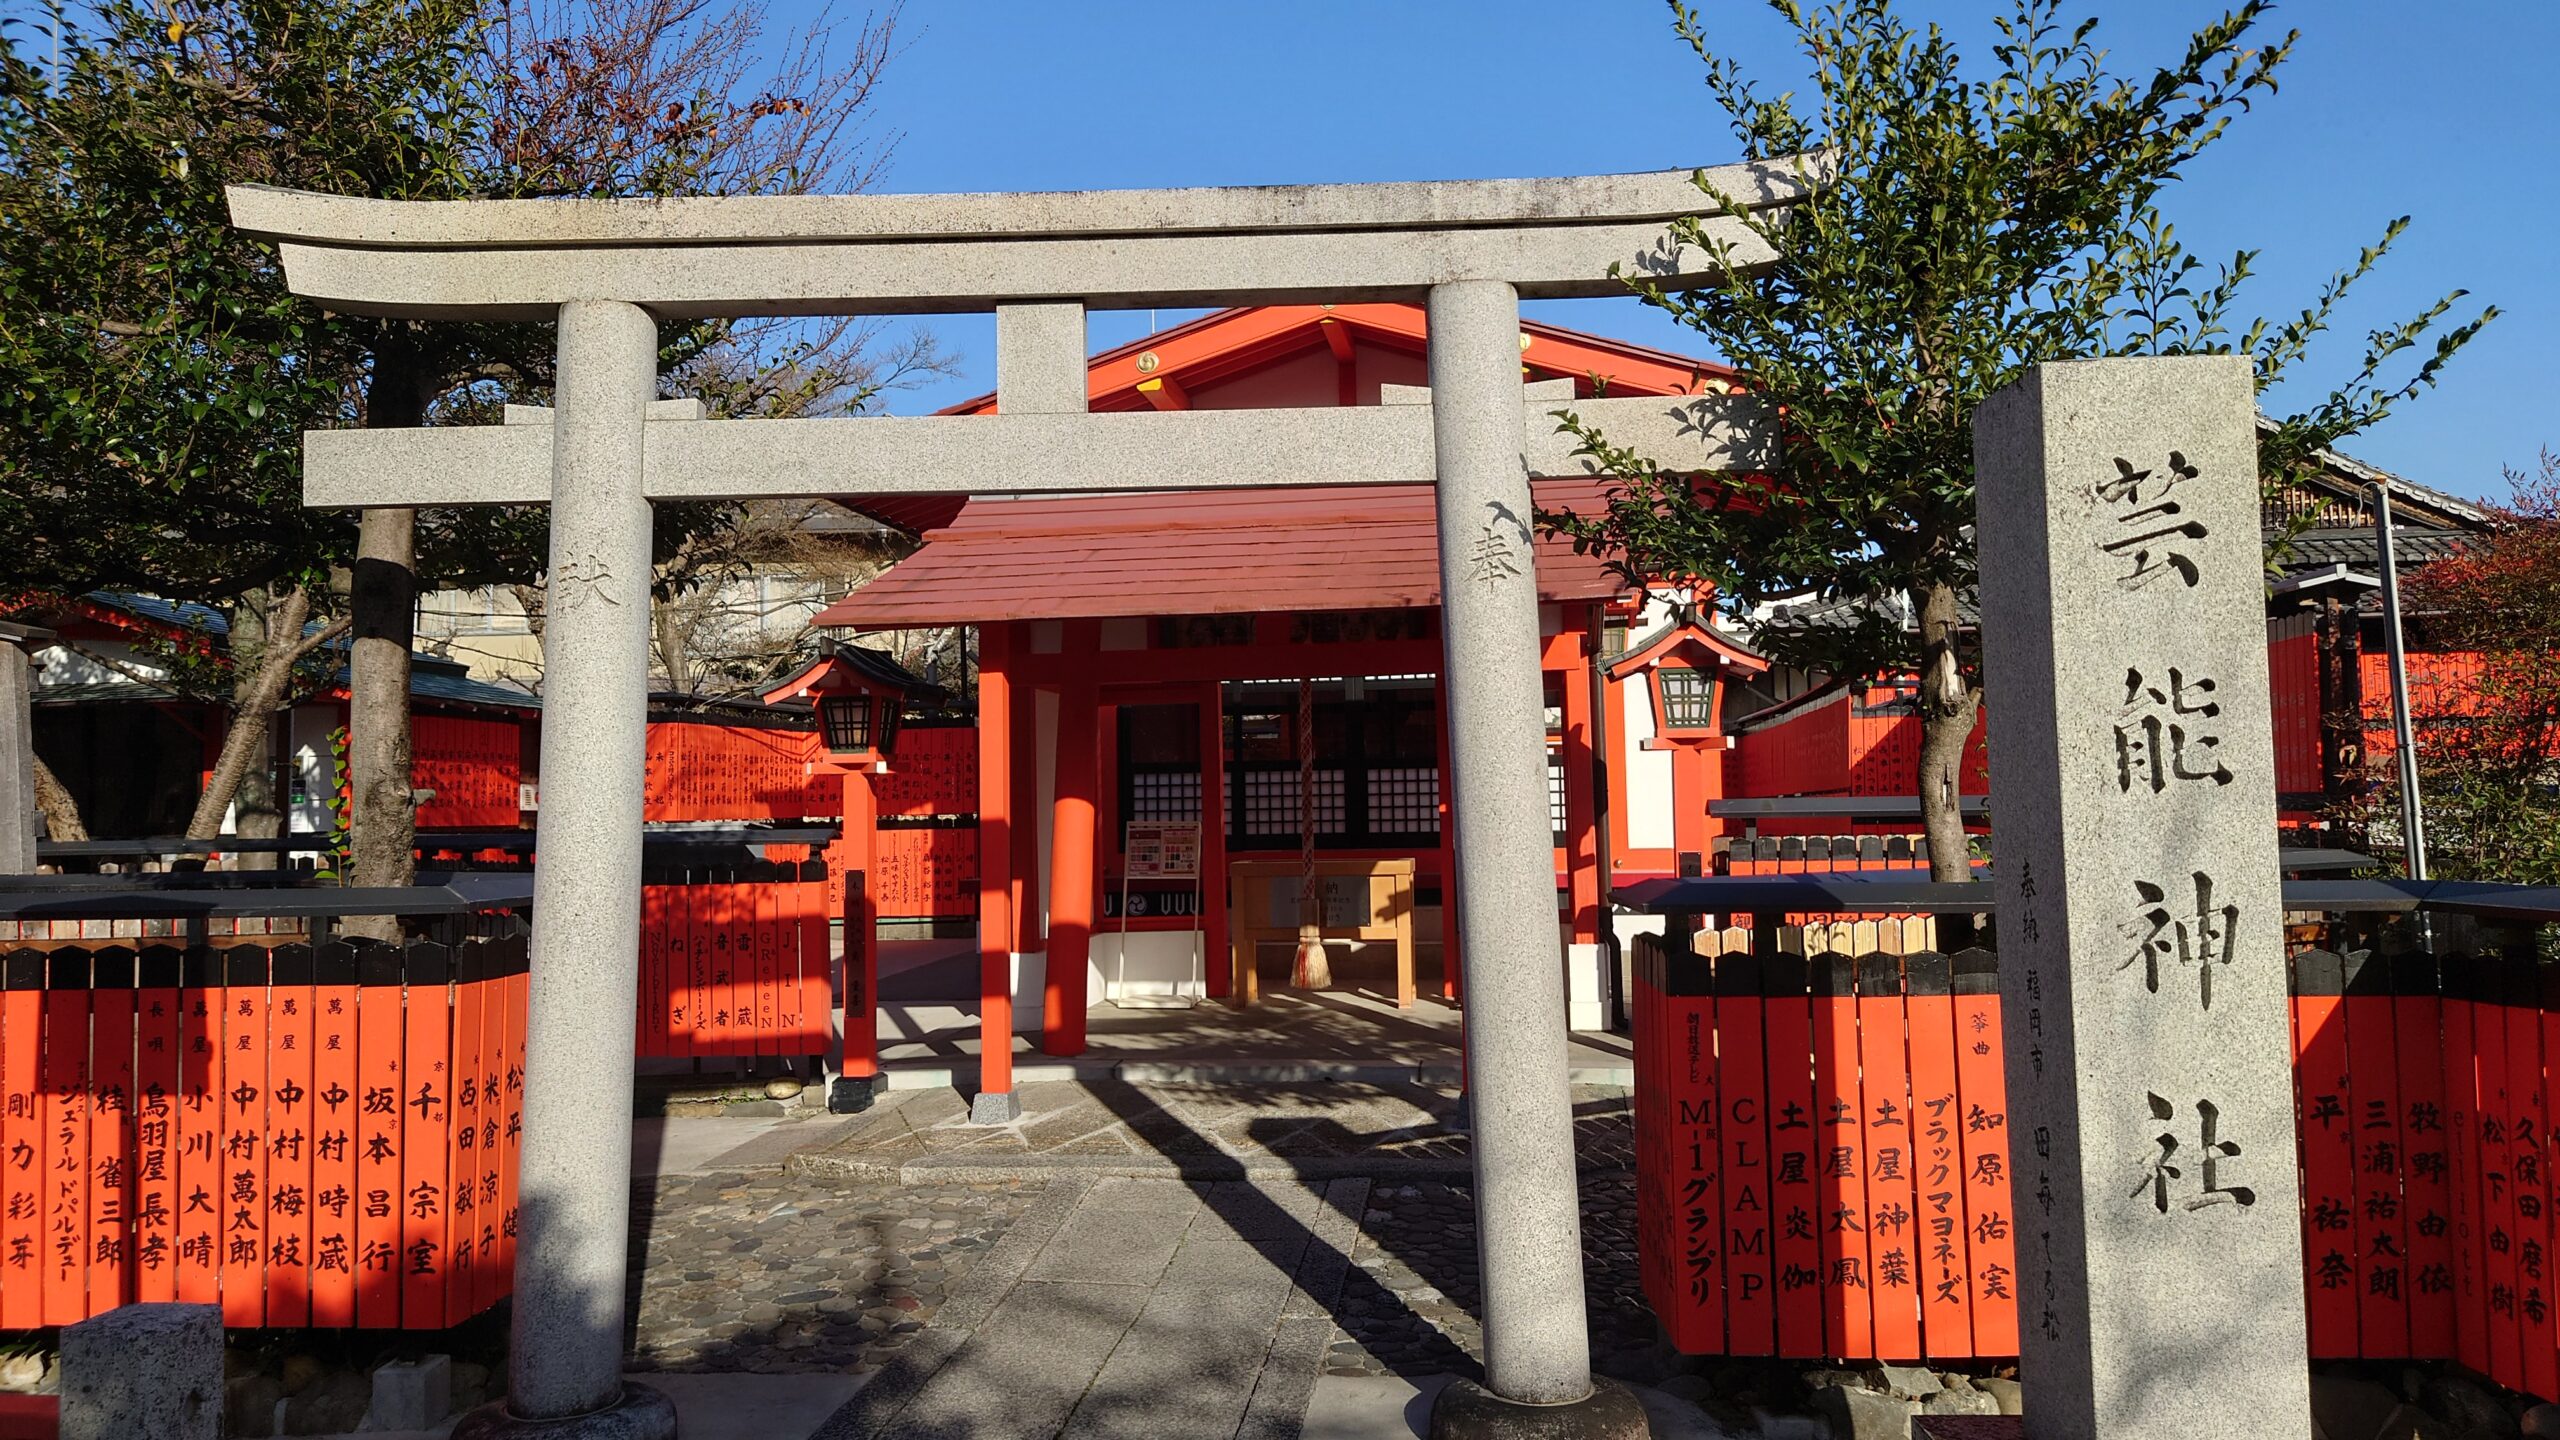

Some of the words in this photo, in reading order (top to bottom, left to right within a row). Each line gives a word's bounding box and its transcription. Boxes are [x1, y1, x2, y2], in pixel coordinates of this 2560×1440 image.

[1464, 526, 1521, 593] 奉
[2095, 450, 2256, 1214] 芸能神社
[238, 999, 254, 1051] 萬屋
[281, 998, 298, 1050] 萬屋
[327, 997, 343, 1050] 萬屋
[735, 933, 753, 1026] 雷蔵
[760, 932, 773, 1028] GReeeeN
[782, 931, 796, 1028] JIN
[6, 1090, 37, 1270] 剛力彩芽
[95, 1083, 127, 1271] 桂雀三郎
[182, 1084, 215, 1270] 小川大晴
[225, 1080, 260, 1271] 中村萬太郎
[271, 1078, 305, 1268] 中村梅枝
[315, 1077, 350, 1275] 中村時蔵
[361, 1086, 397, 1273] 坂本昌行
[408, 1083, 440, 1276] 千宗室
[433, 1061, 445, 1123] 京都
[455, 1078, 477, 1271] 西田敏行
[480, 1072, 499, 1257] 米倉涼子
[1731, 1098, 1764, 1300] CLAMP
[1775, 1101, 1817, 1291] 土屋炎伽
[1823, 1098, 1867, 1289] 土屋太鳳
[1871, 1098, 1910, 1288] 土屋神葉
[1924, 1092, 1961, 1304] ブラックマヨネーズ
[1966, 1103, 2011, 1300] 知原佑実
[2309, 1095, 2353, 1290] 平祐奈
[2361, 1100, 2400, 1299] 三浦祐太朗
[2408, 1101, 2454, 1295] 牧野由依
[2482, 1112, 2516, 1321] 松下由樹
[2514, 1115, 2547, 1330] 久保田磨希
